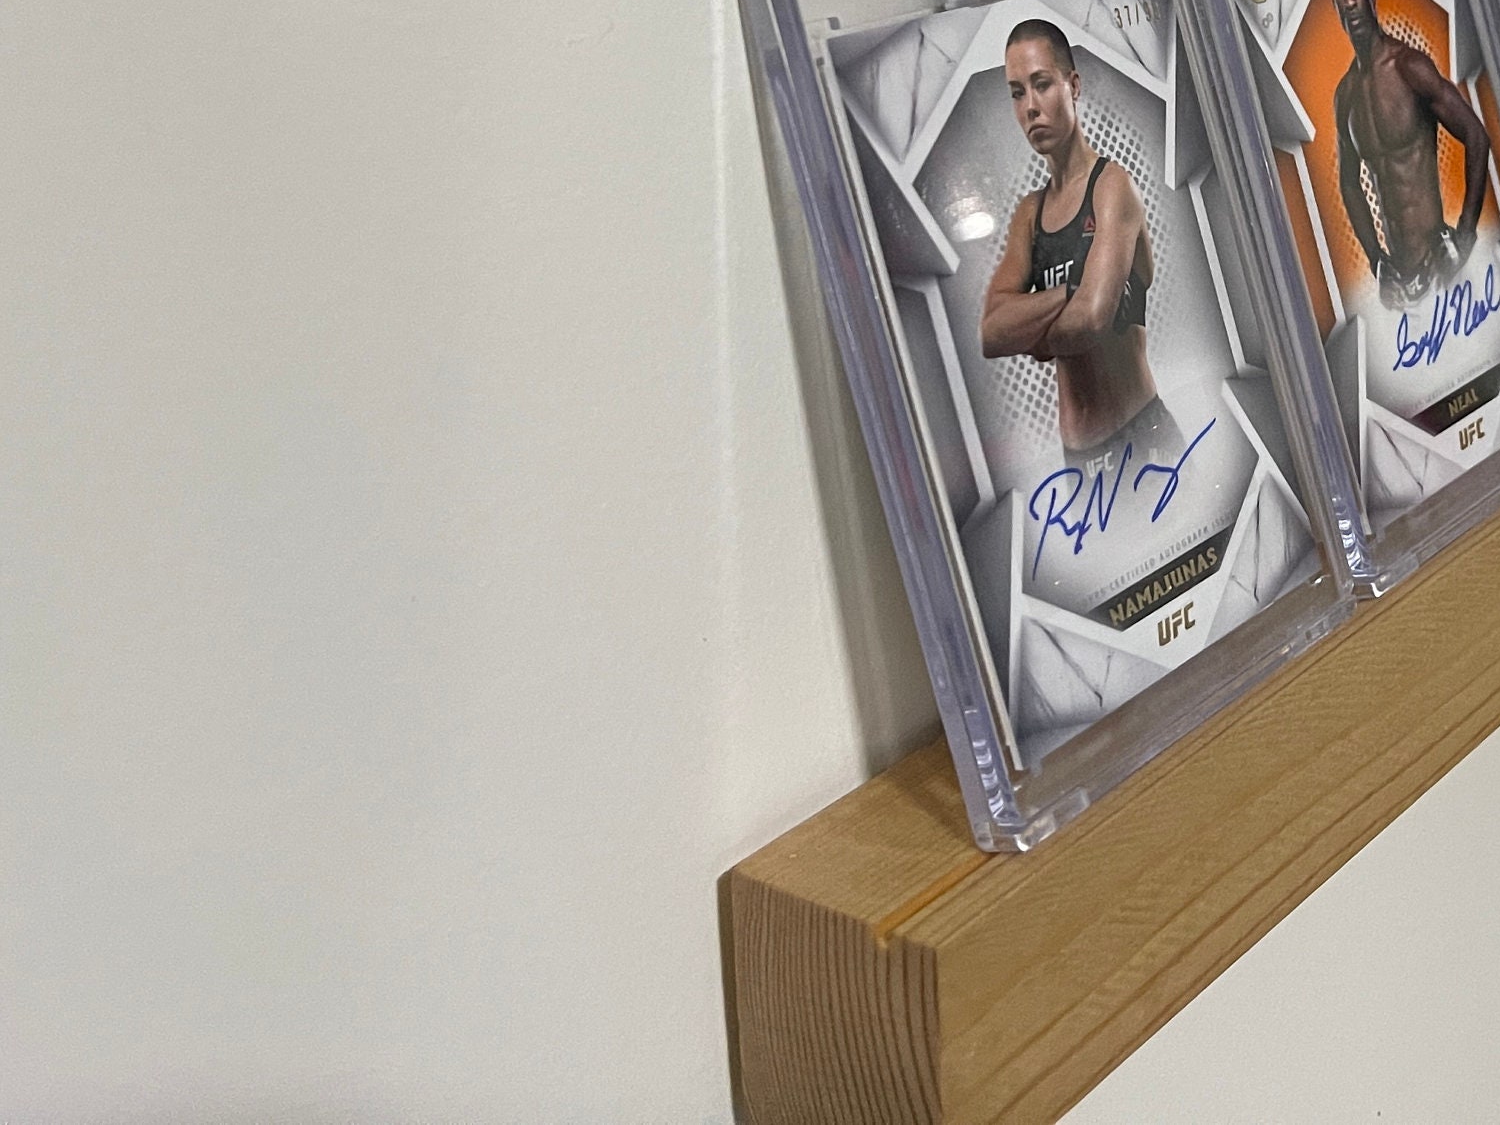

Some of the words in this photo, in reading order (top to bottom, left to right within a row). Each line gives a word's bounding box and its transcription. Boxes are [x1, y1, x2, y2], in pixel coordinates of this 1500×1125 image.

[1447, 388, 1480, 418] NEAL
[1458, 417, 1485, 451] UFC
[1085, 450, 1115, 478] UFC
[1108, 546, 1219, 627] NAMAJUNAS
[1157, 601, 1197, 647] UFC
